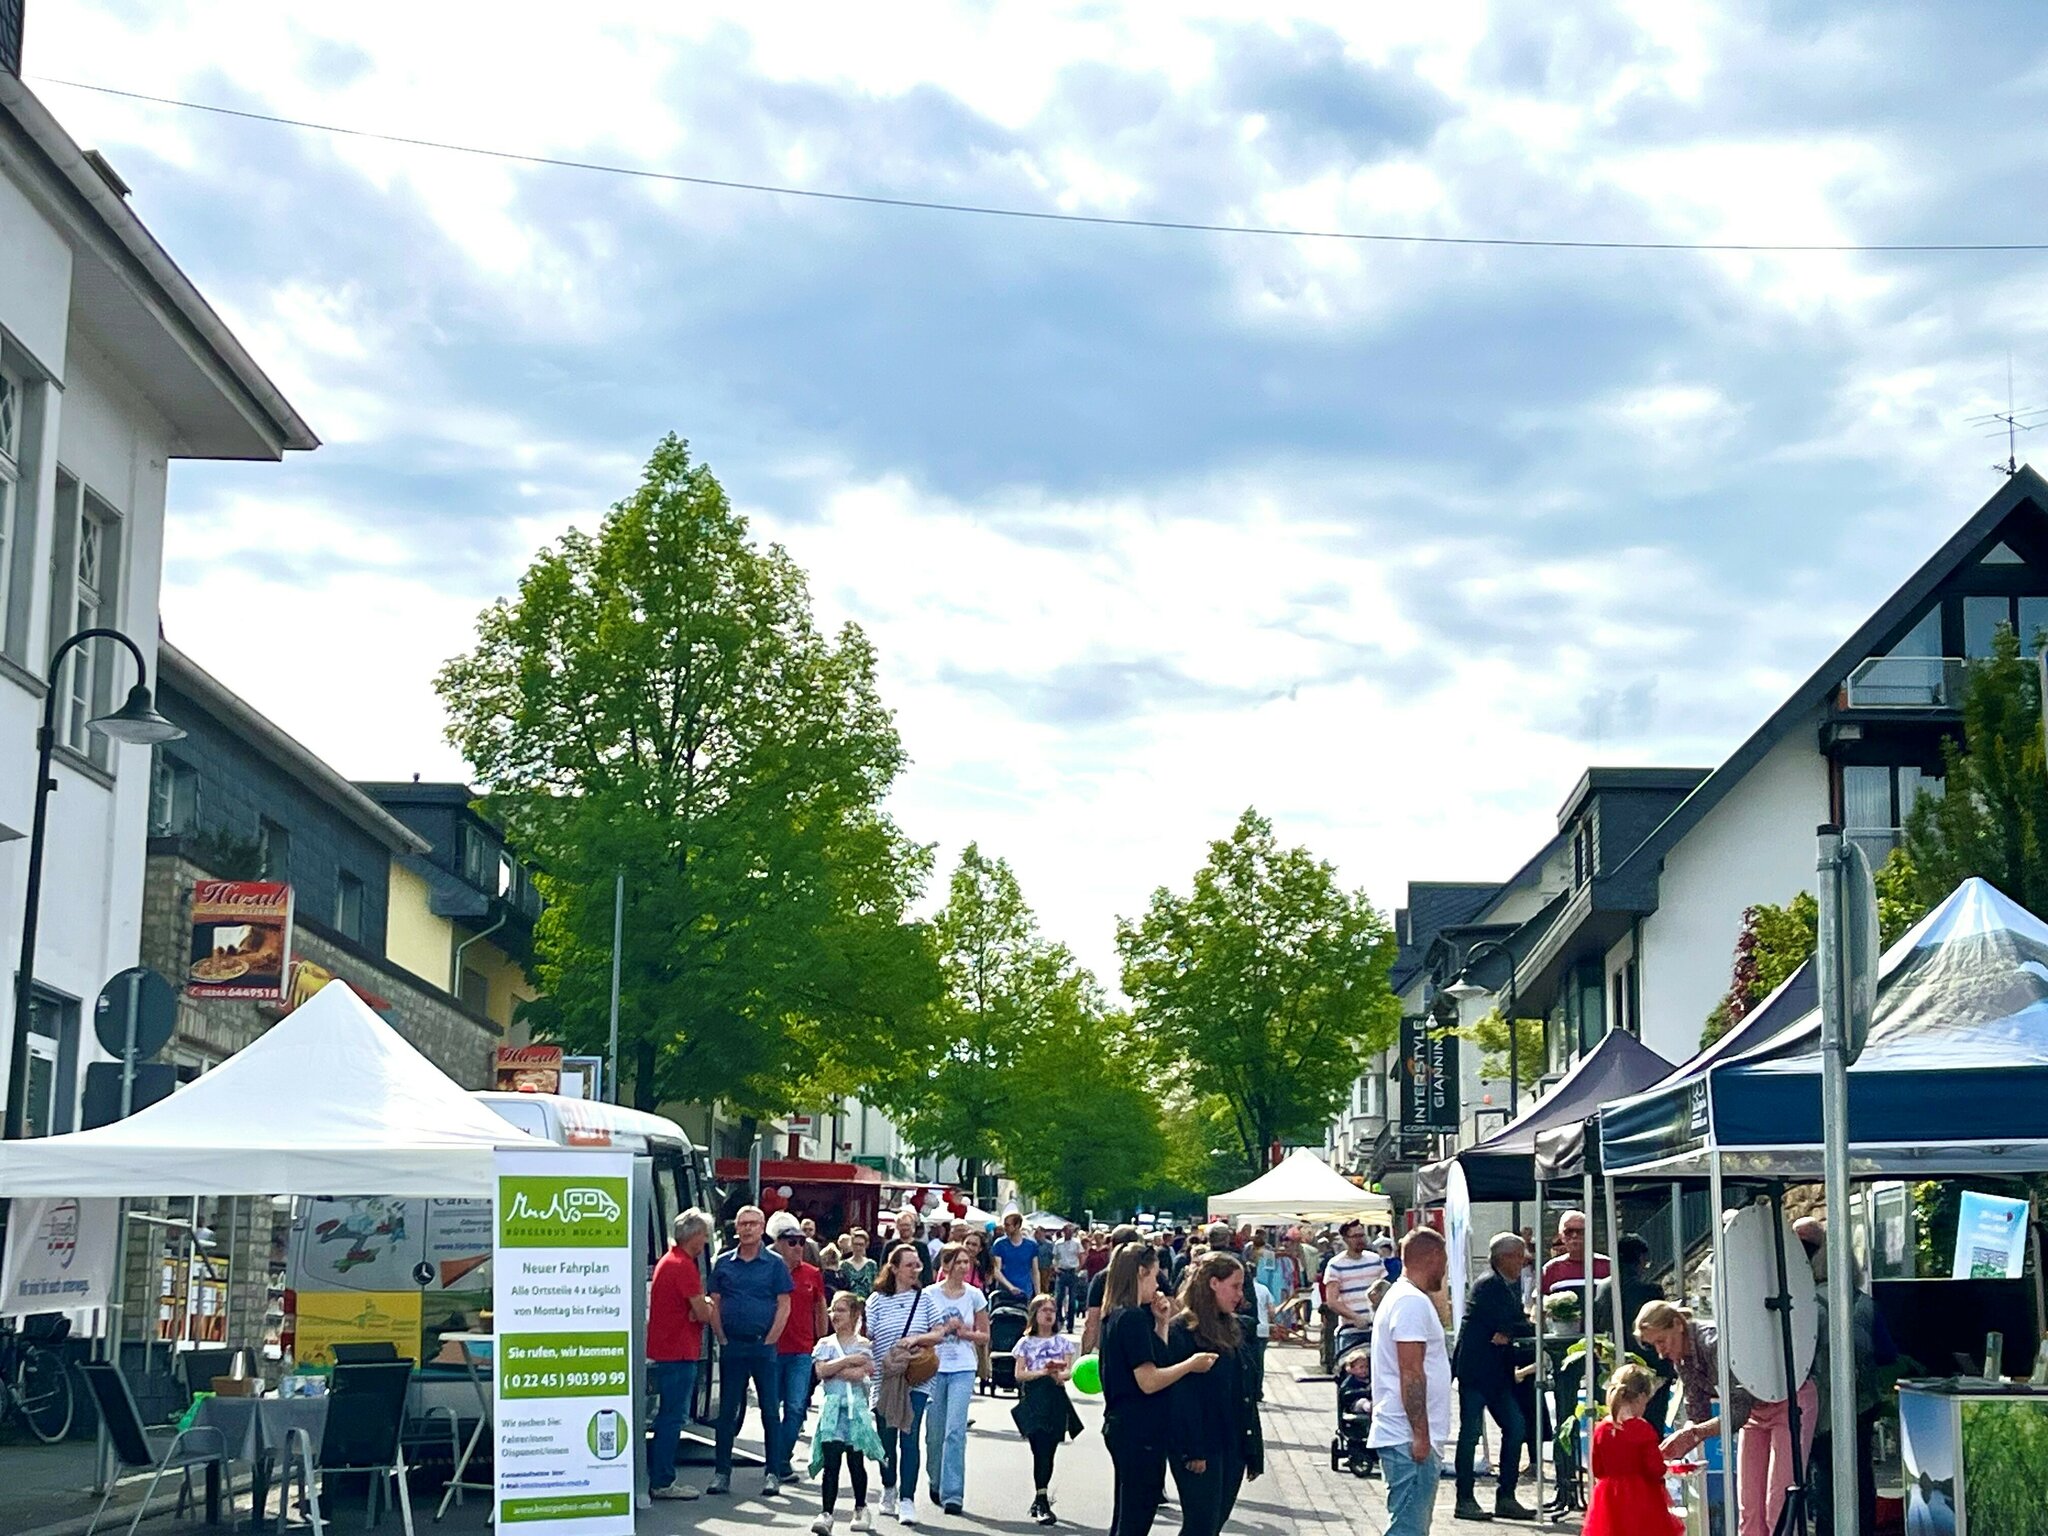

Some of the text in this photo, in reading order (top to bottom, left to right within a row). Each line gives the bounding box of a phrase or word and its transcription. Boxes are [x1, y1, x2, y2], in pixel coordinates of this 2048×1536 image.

[1413, 1020, 1426, 1123] INTERSTYLE
[1433, 1040, 1445, 1109] GIANNIN
[522, 1262, 610, 1276] Neuer Fahrplan
[511, 1286, 530, 1295] Alle
[532, 1286, 572, 1295] Ortsteile
[574, 1286, 580, 1295] 4
[588, 1285, 621, 1297] täglich
[533, 1306, 570, 1318] Montag
[572, 1306, 584, 1315] bis
[586, 1305, 620, 1317] Freitag
[508, 1345, 624, 1359] Sie rufen, wir kommen
[512, 1375, 520, 1387] 0
[523, 1374, 539, 1387] 22
[541, 1374, 557, 1387] 45
[567, 1373, 589, 1386] 903
[591, 1372, 607, 1385] 99
[609, 1372, 626, 1385] 99
